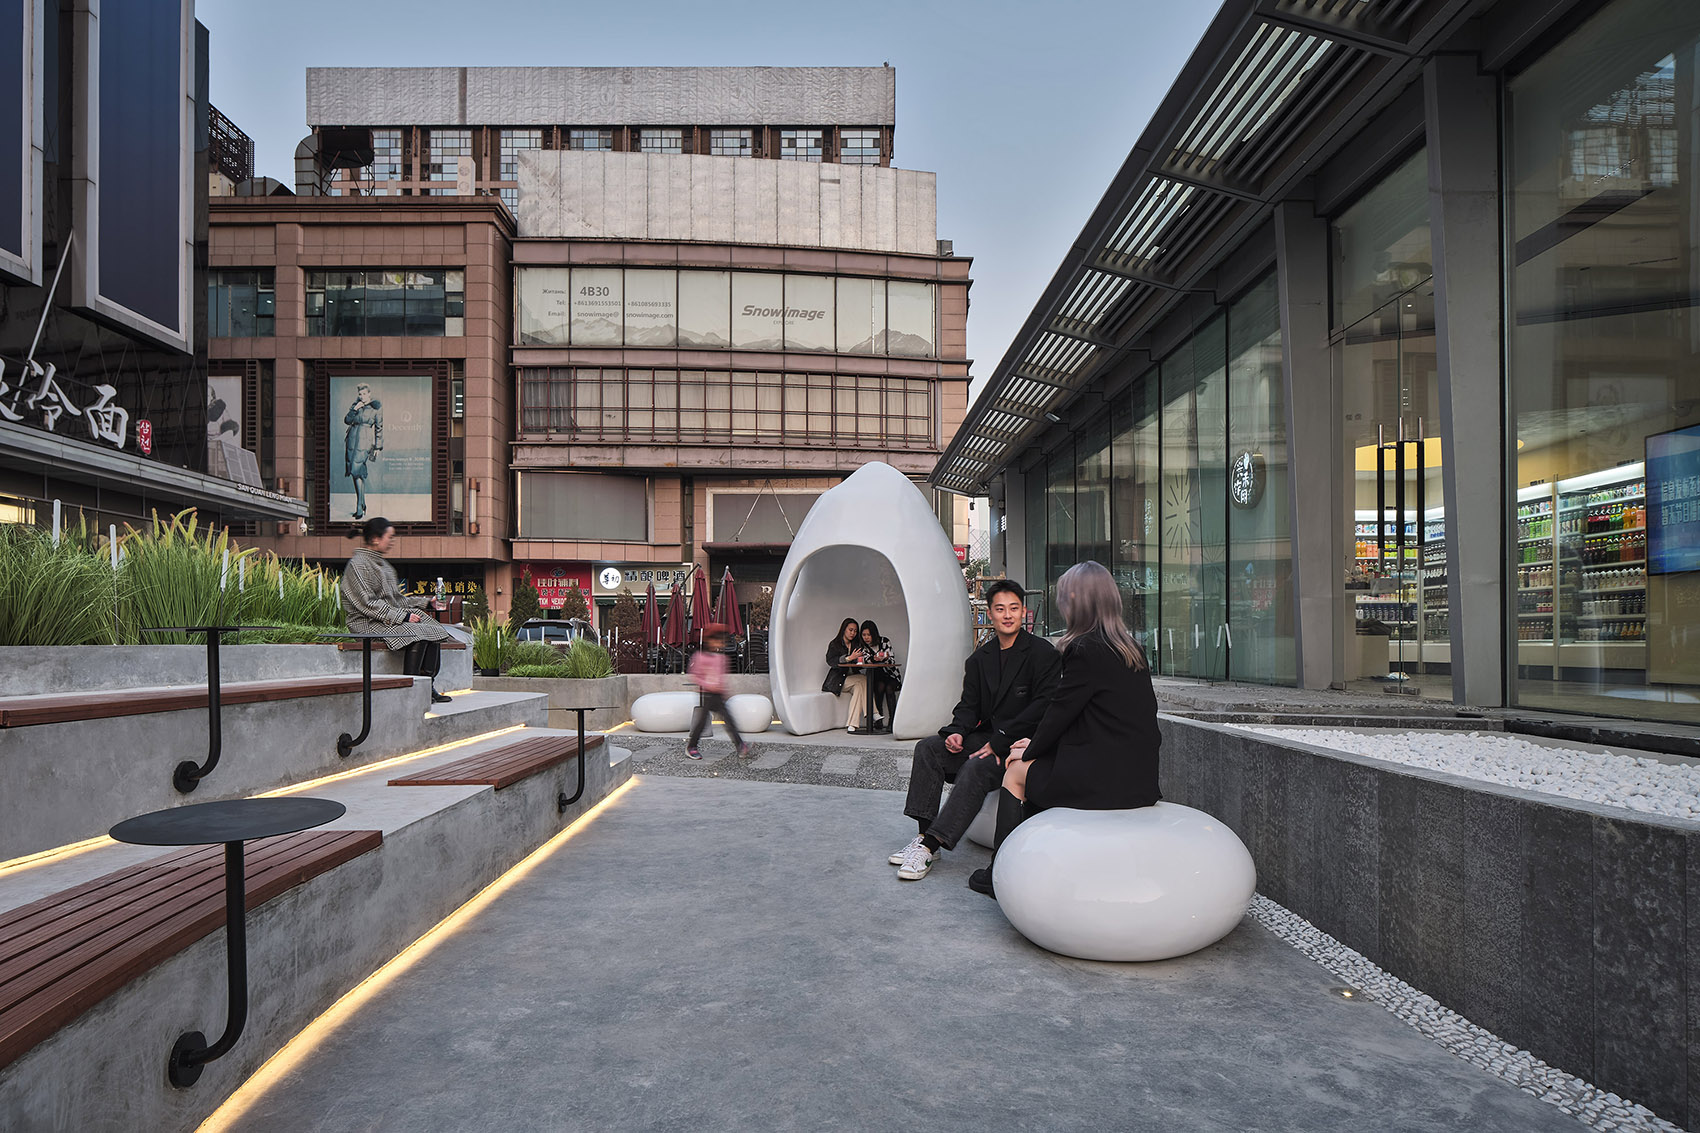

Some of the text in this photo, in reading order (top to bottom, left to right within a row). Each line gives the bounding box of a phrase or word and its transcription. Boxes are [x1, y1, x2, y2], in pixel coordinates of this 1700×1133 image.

[579, 286, 610, 297] 4B30
[741, 304, 826, 321] Snowimage
[1661, 475, 1700, 502] 信息发布系
[1661, 500, 1700, 526] 暂无节目信
